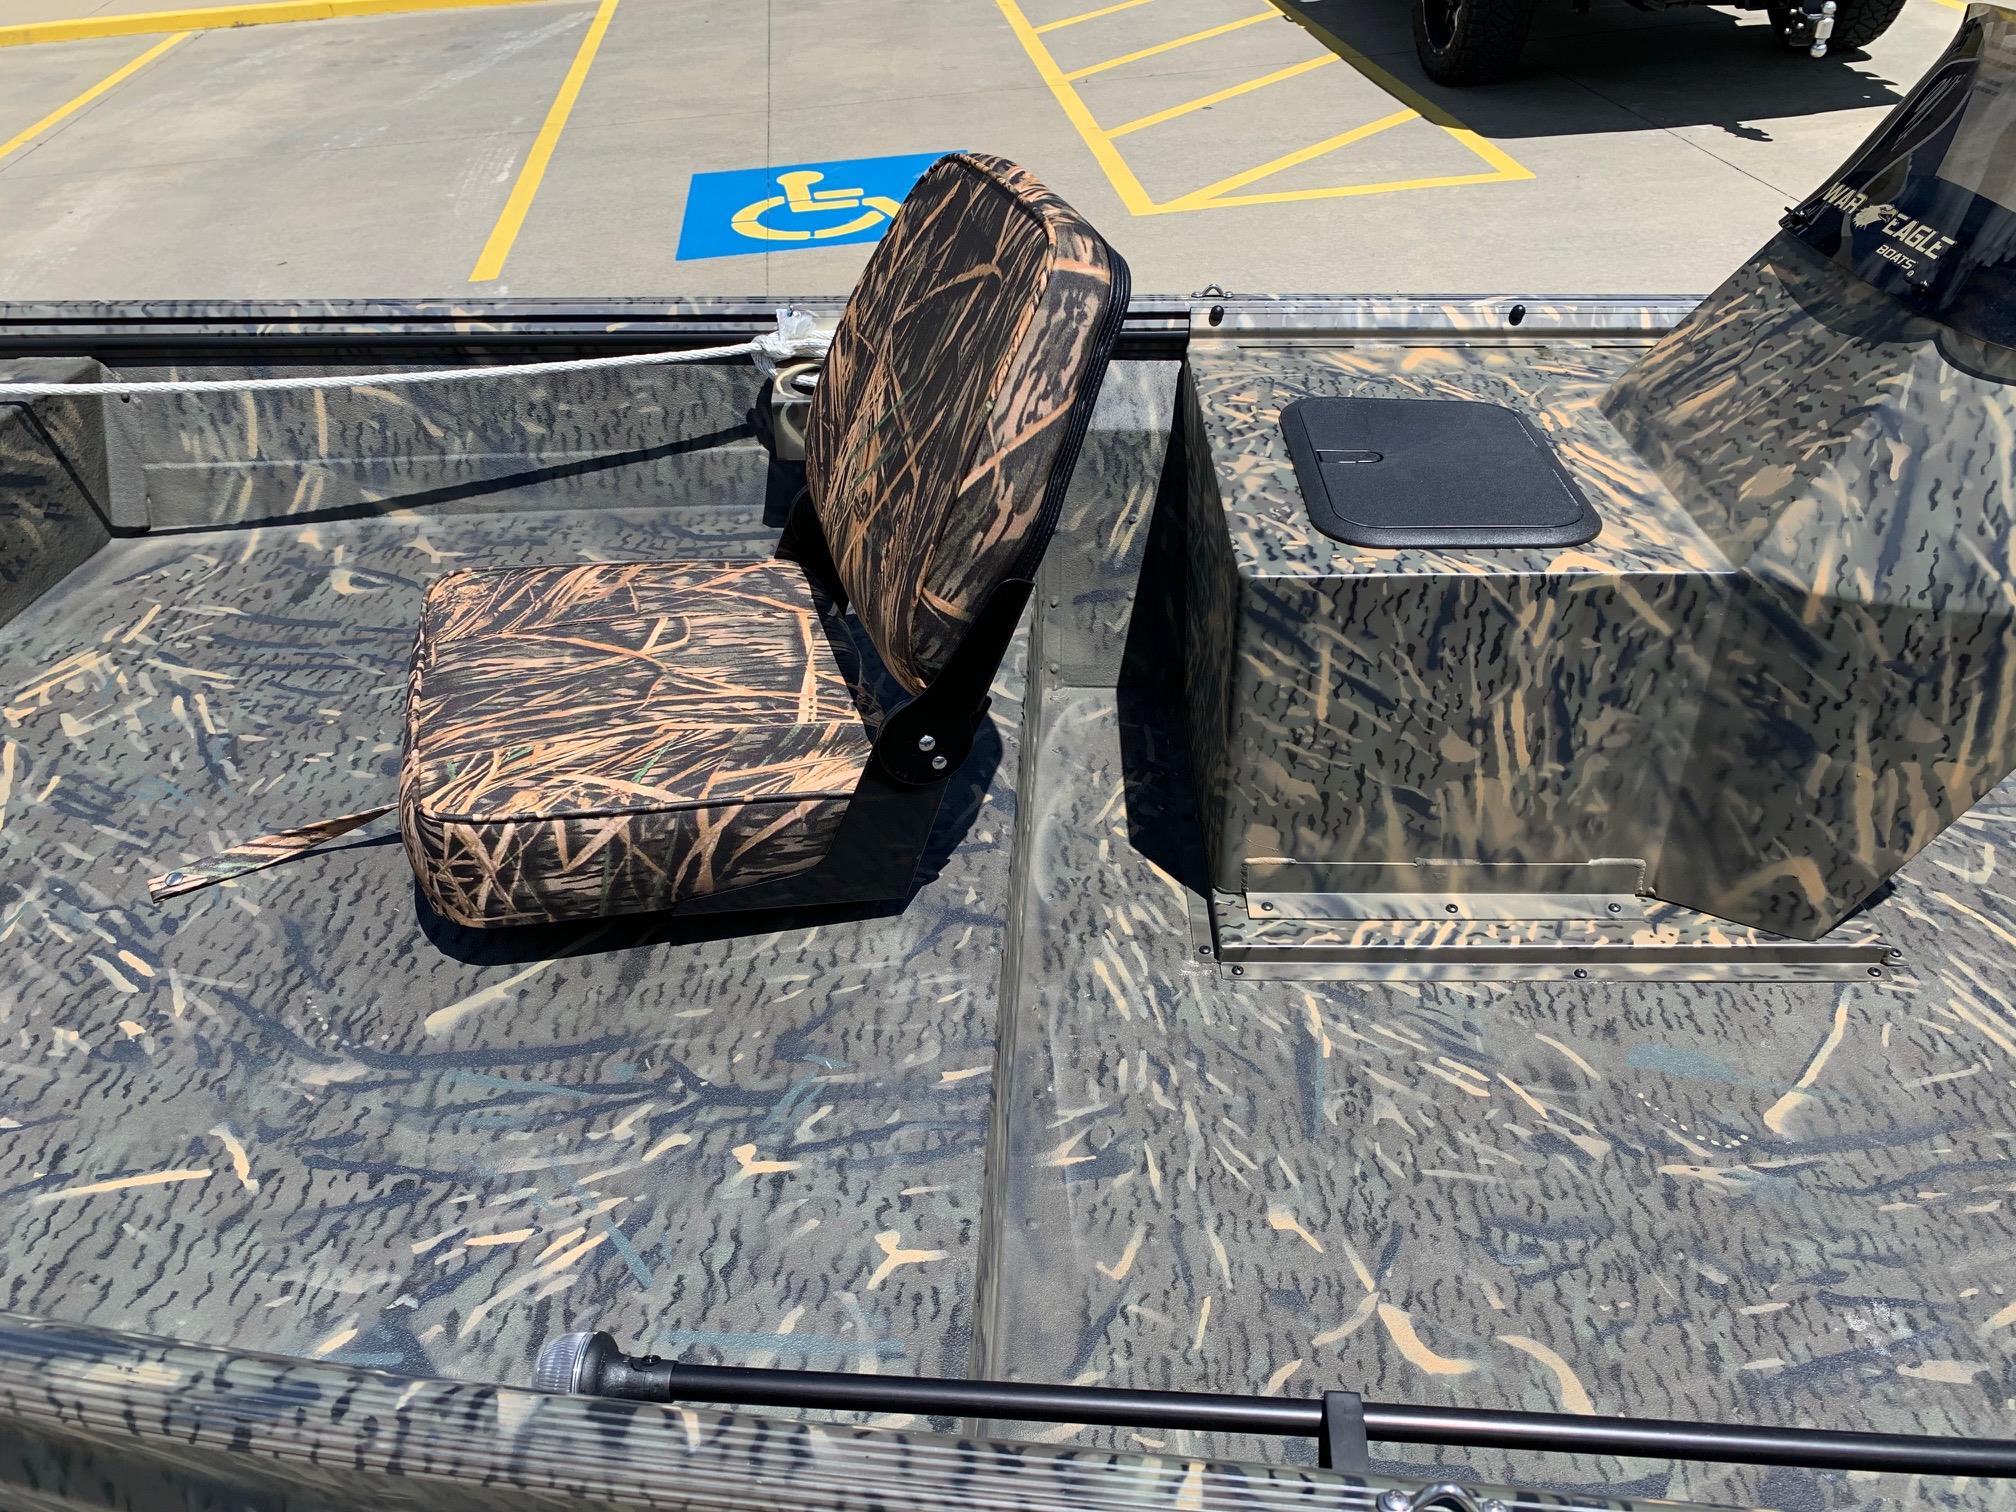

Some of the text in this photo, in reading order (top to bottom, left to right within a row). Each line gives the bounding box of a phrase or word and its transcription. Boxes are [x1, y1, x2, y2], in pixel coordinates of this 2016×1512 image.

[1822, 183, 1957, 260] WAR EAGLE
[1876, 244, 1917, 270] BOATS
